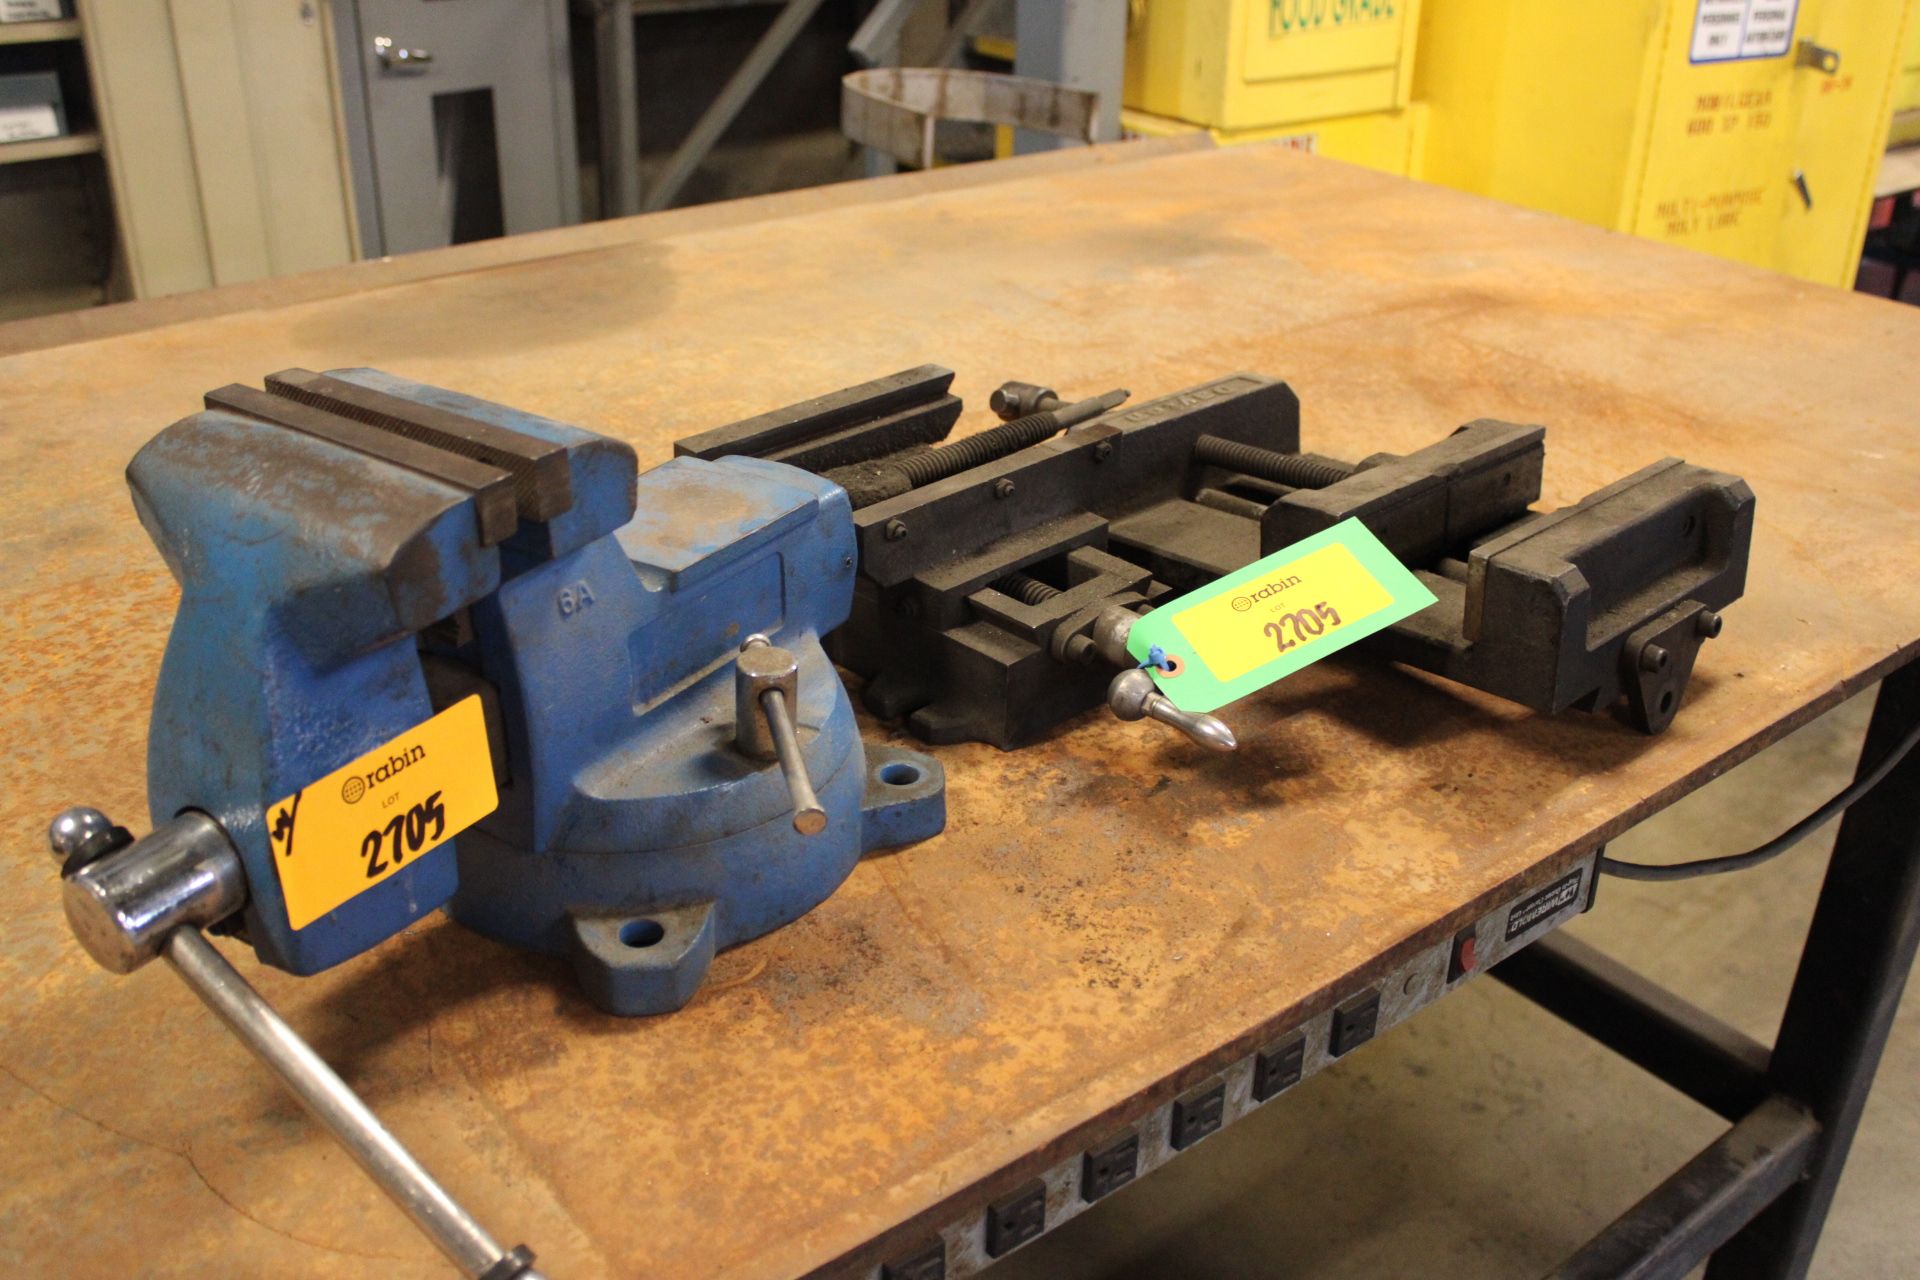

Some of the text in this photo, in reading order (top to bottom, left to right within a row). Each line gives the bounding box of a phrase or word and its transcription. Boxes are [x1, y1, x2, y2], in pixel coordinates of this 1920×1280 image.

[558, 580, 596, 614] 6A
[1250, 574, 1302, 604] rabin
[1270, 602, 1287, 613] LOT
[1264, 601, 1342, 653] 2705
[366, 744, 426, 789] rabin
[381, 792, 401, 809] LOT
[360, 790, 446, 879] 2705
